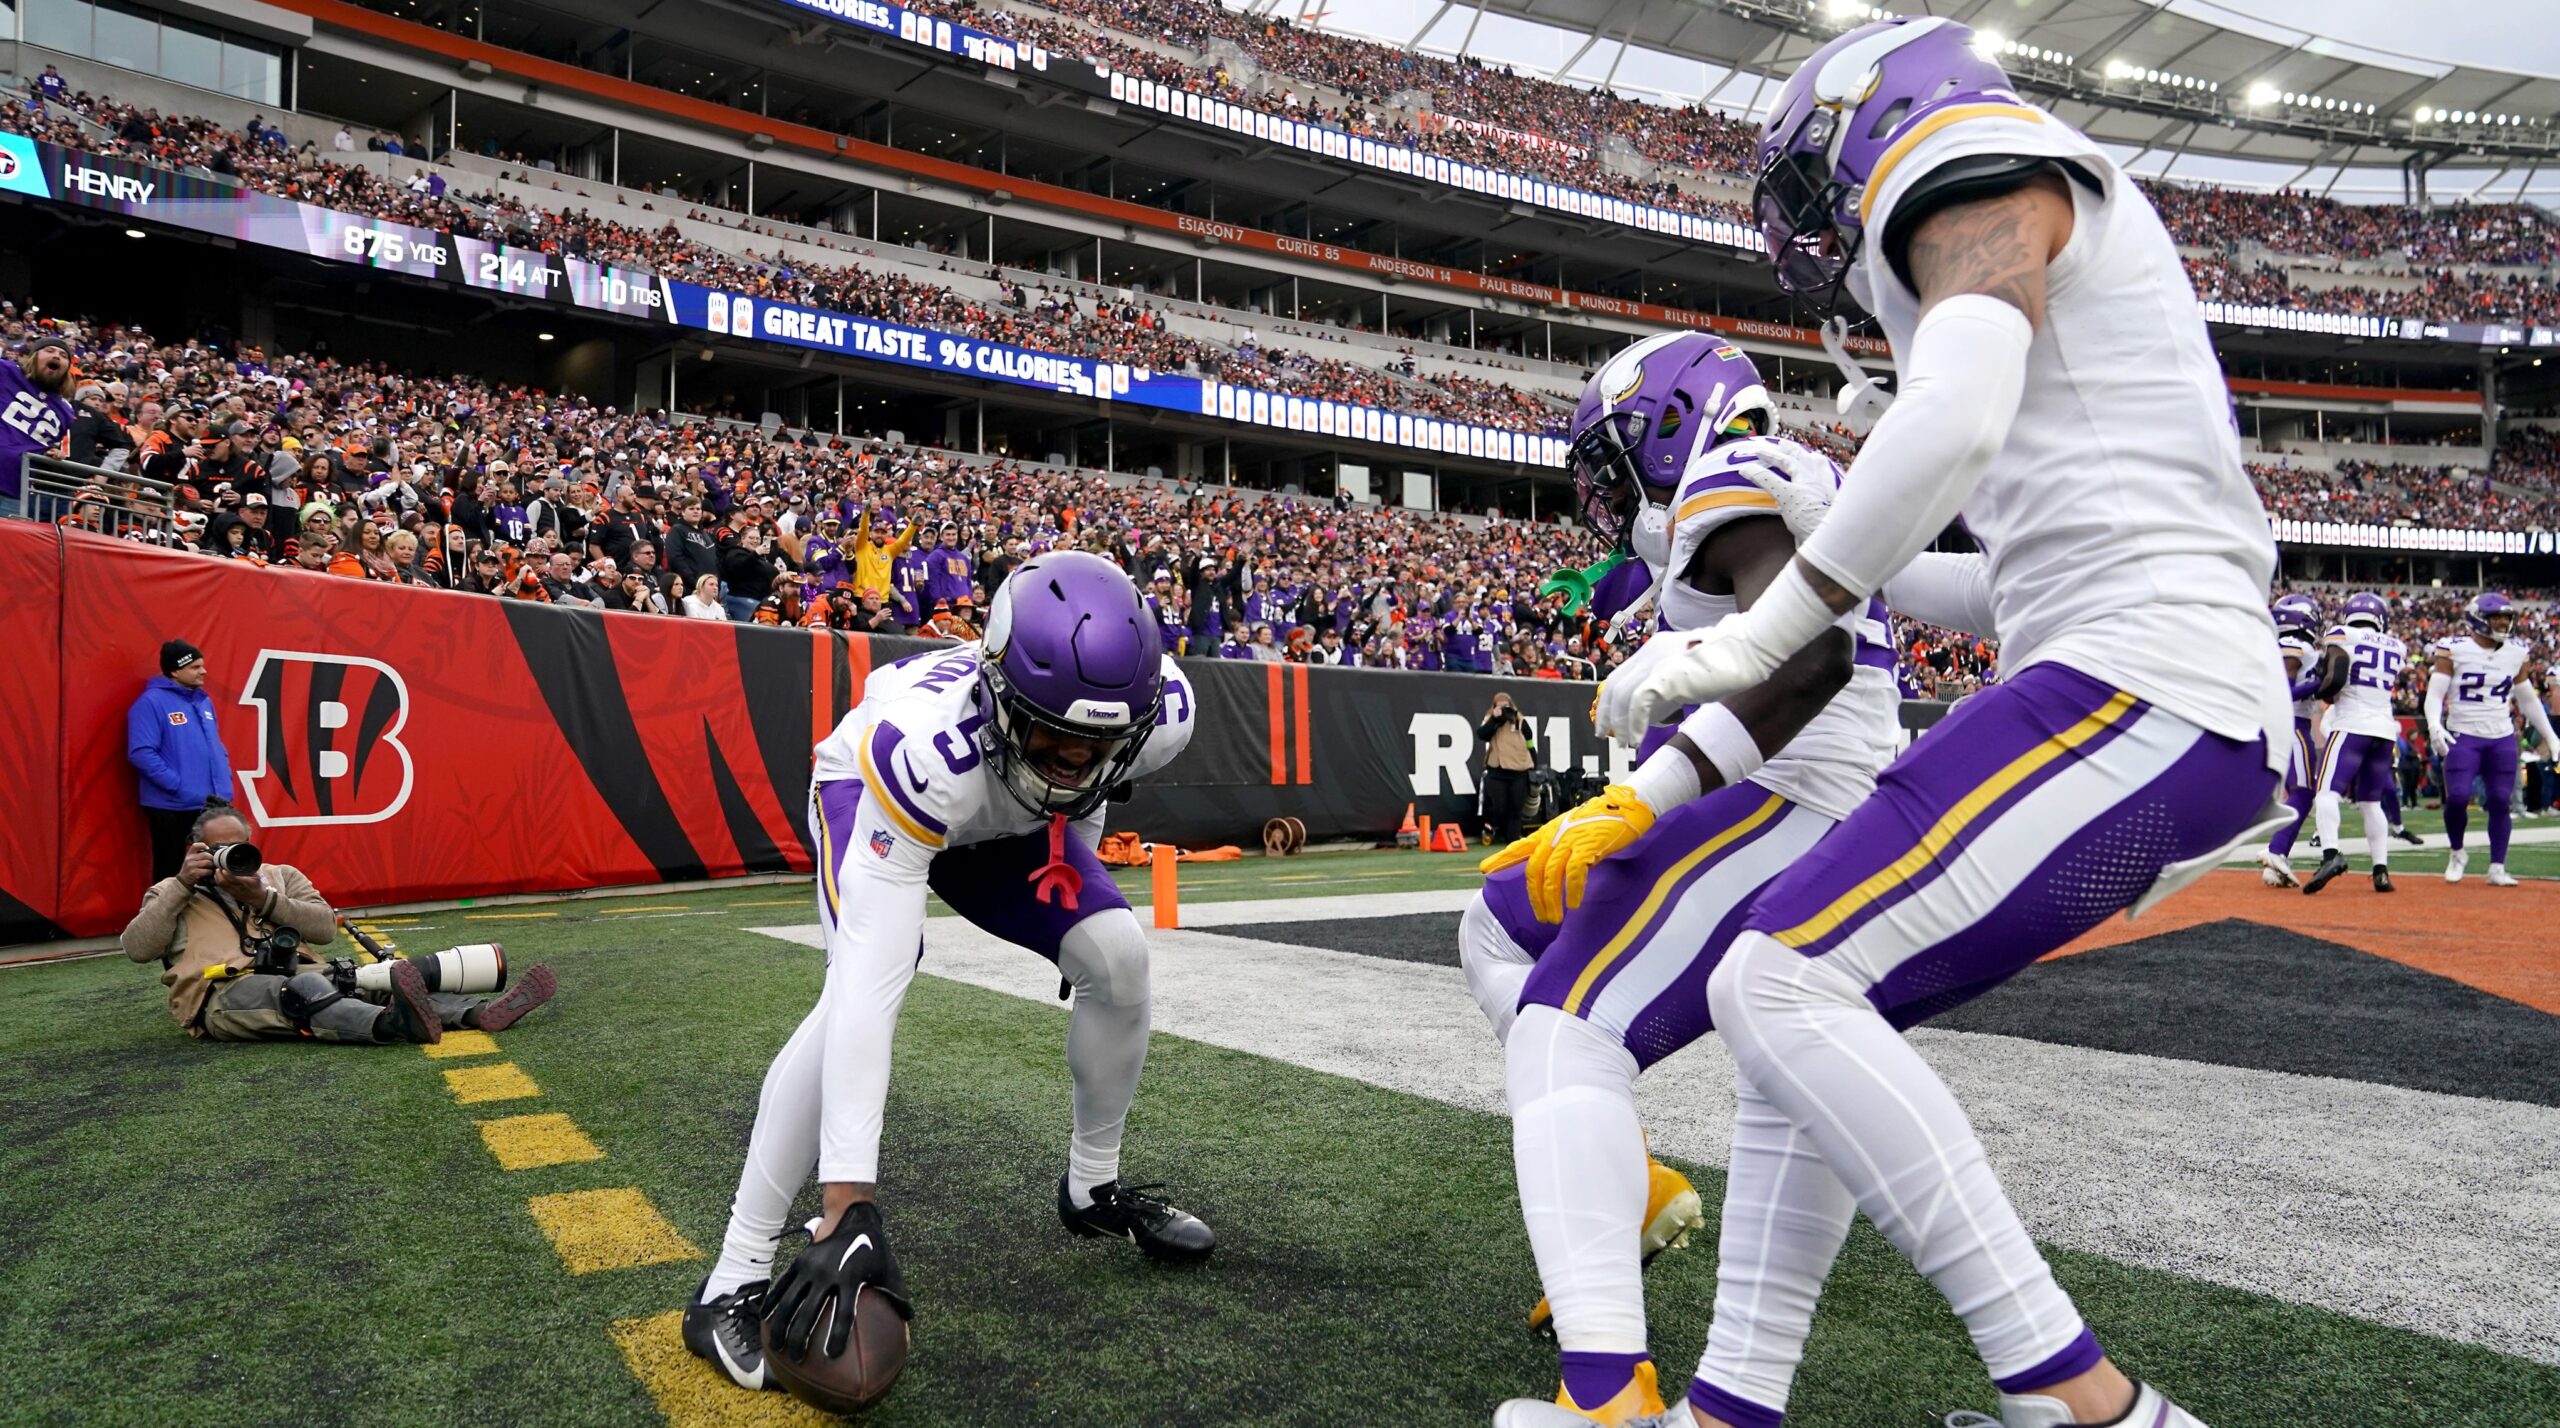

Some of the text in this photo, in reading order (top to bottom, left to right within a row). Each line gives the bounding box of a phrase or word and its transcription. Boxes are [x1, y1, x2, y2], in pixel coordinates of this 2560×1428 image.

[64, 163, 155, 205] HENRY
[1178, 216, 1244, 241] ESIASON 7
[344, 224, 448, 266] 875 YDS
[1276, 238, 1341, 261] CURTIS 85
[480, 253, 562, 288] 214 ATT
[1369, 256, 1451, 282] ANDERSON 14
[600, 276, 661, 308] 10 TDS
[1479, 277, 1553, 301] PAUL BROWN
[1626, 302, 1640, 316] 78
[1664, 310, 1712, 328] RILEY 13
[763, 307, 848, 347] GREAT
[851, 322, 933, 362] TASTE.
[939, 339, 972, 369] 96
[1736, 321, 1806, 340] ANDERSON 71
[1874, 343, 1887, 353] 85
[1, 391, 61, 447] 22
[507, 520, 524, 541] 18
[629, 523, 640, 541] 1
[2350, 644, 2401, 692] 25
[2459, 672, 2514, 704] 24
